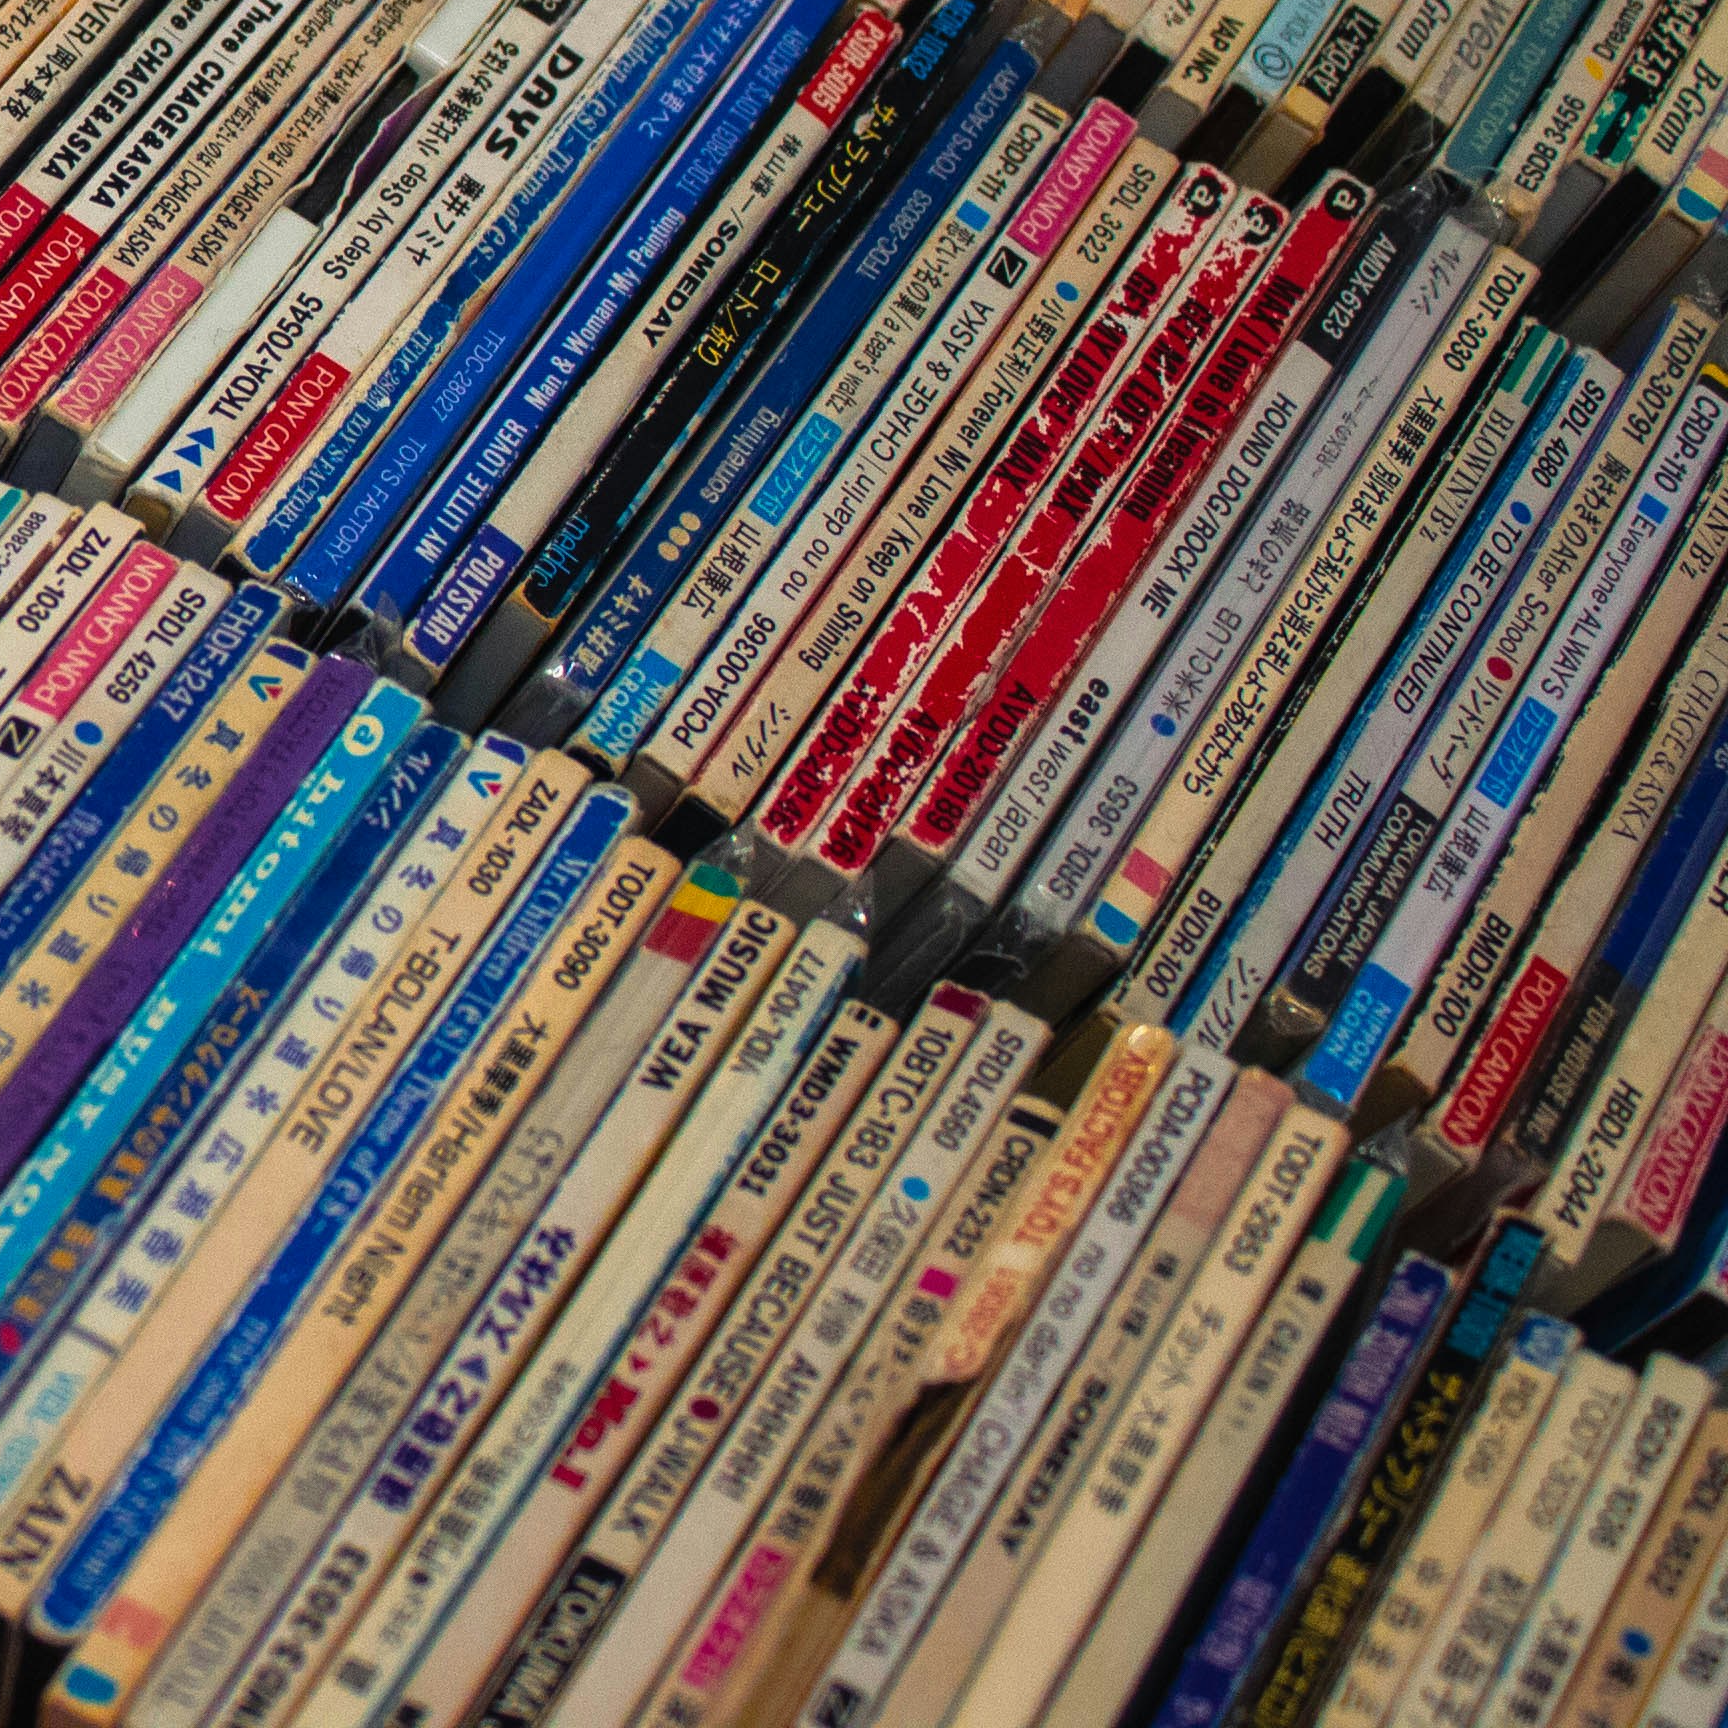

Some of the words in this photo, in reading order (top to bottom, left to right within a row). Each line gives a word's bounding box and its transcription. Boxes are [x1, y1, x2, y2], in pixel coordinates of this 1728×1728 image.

[1305, 12, 1379, 95] APDA-71
[32, 35, 184, 184] CHAGE&ASKA
[476, 45, 588, 159] DAYS
[378, 159, 437, 212] Step
[1510, 139, 1563, 195] ESDB
[320, 232, 377, 284] Step
[358, 205, 400, 239] by
[203, 291, 333, 425] TKDA-70545
[269, 363, 338, 432] PONY
[434, 474, 495, 534] LITTLE
[471, 417, 536, 479] LOVER
[520, 369, 569, 412] Man
[665, 610, 785, 748] PCDA-00366
[934, 296, 998, 362] ASKA
[1015, 184, 1073, 245] PONY
[1049, 110, 1128, 193] CANYON
[1232, 391, 1302, 468] HOUND
[1555, 379, 1610, 443] SRDL
[204, 420, 296, 511] CANYON
[693, 404, 785, 505] something
[1152, 461, 1258, 582] DOG/ROCK
[25, 638, 100, 709] PONY
[76, 553, 174, 649] CANYON
[148, 586, 208, 644] SRDL
[1139, 577, 1179, 616] ME
[100, 640, 167, 704] 4259
[1382, 581, 1490, 718] CONTINUED
[1053, 674, 1125, 748] east
[1020, 738, 1075, 797] west
[1310, 770, 1377, 850] TRUTH
[966, 788, 1044, 873] japan
[633, 1009, 714, 1096] WEA
[689, 906, 788, 1016] MUSIC
[1422, 911, 1520, 1038] BMDR-100
[273, 922, 476, 1153] T-BOLAN/LOVE
[1543, 1078, 1653, 1228] HBDL-2044
